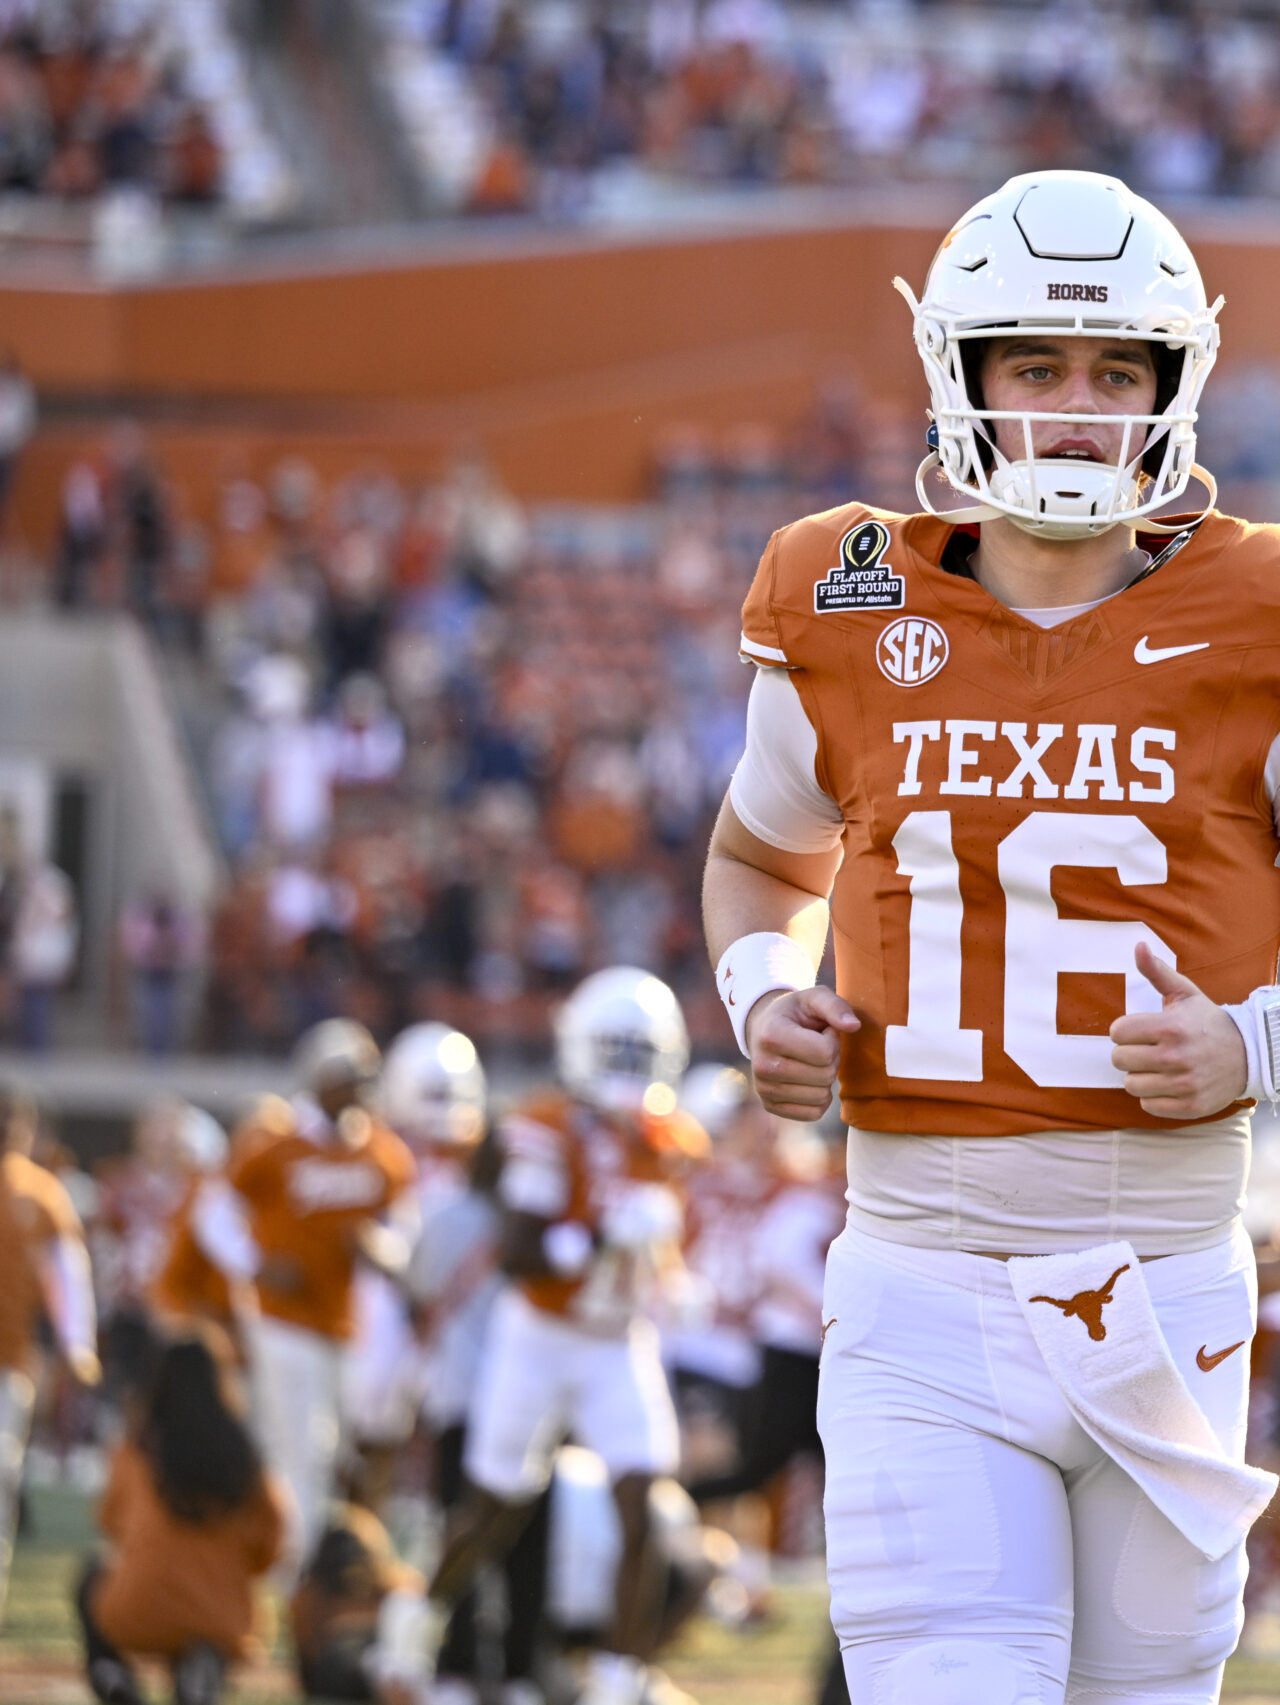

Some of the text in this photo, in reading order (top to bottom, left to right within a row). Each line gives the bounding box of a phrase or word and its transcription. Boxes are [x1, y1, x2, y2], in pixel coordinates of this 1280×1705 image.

[1047, 283, 1108, 303] HORNS
[833, 570, 886, 584] PLAYOFF
[819, 581, 900, 597] FIRST ROUND
[825, 596, 856, 605] PRESENTED
[865, 594, 892, 604] Allstate
[882, 620, 943, 683] SEC
[892, 719, 1177, 804] TEXAS
[885, 810, 1178, 1090] 16
